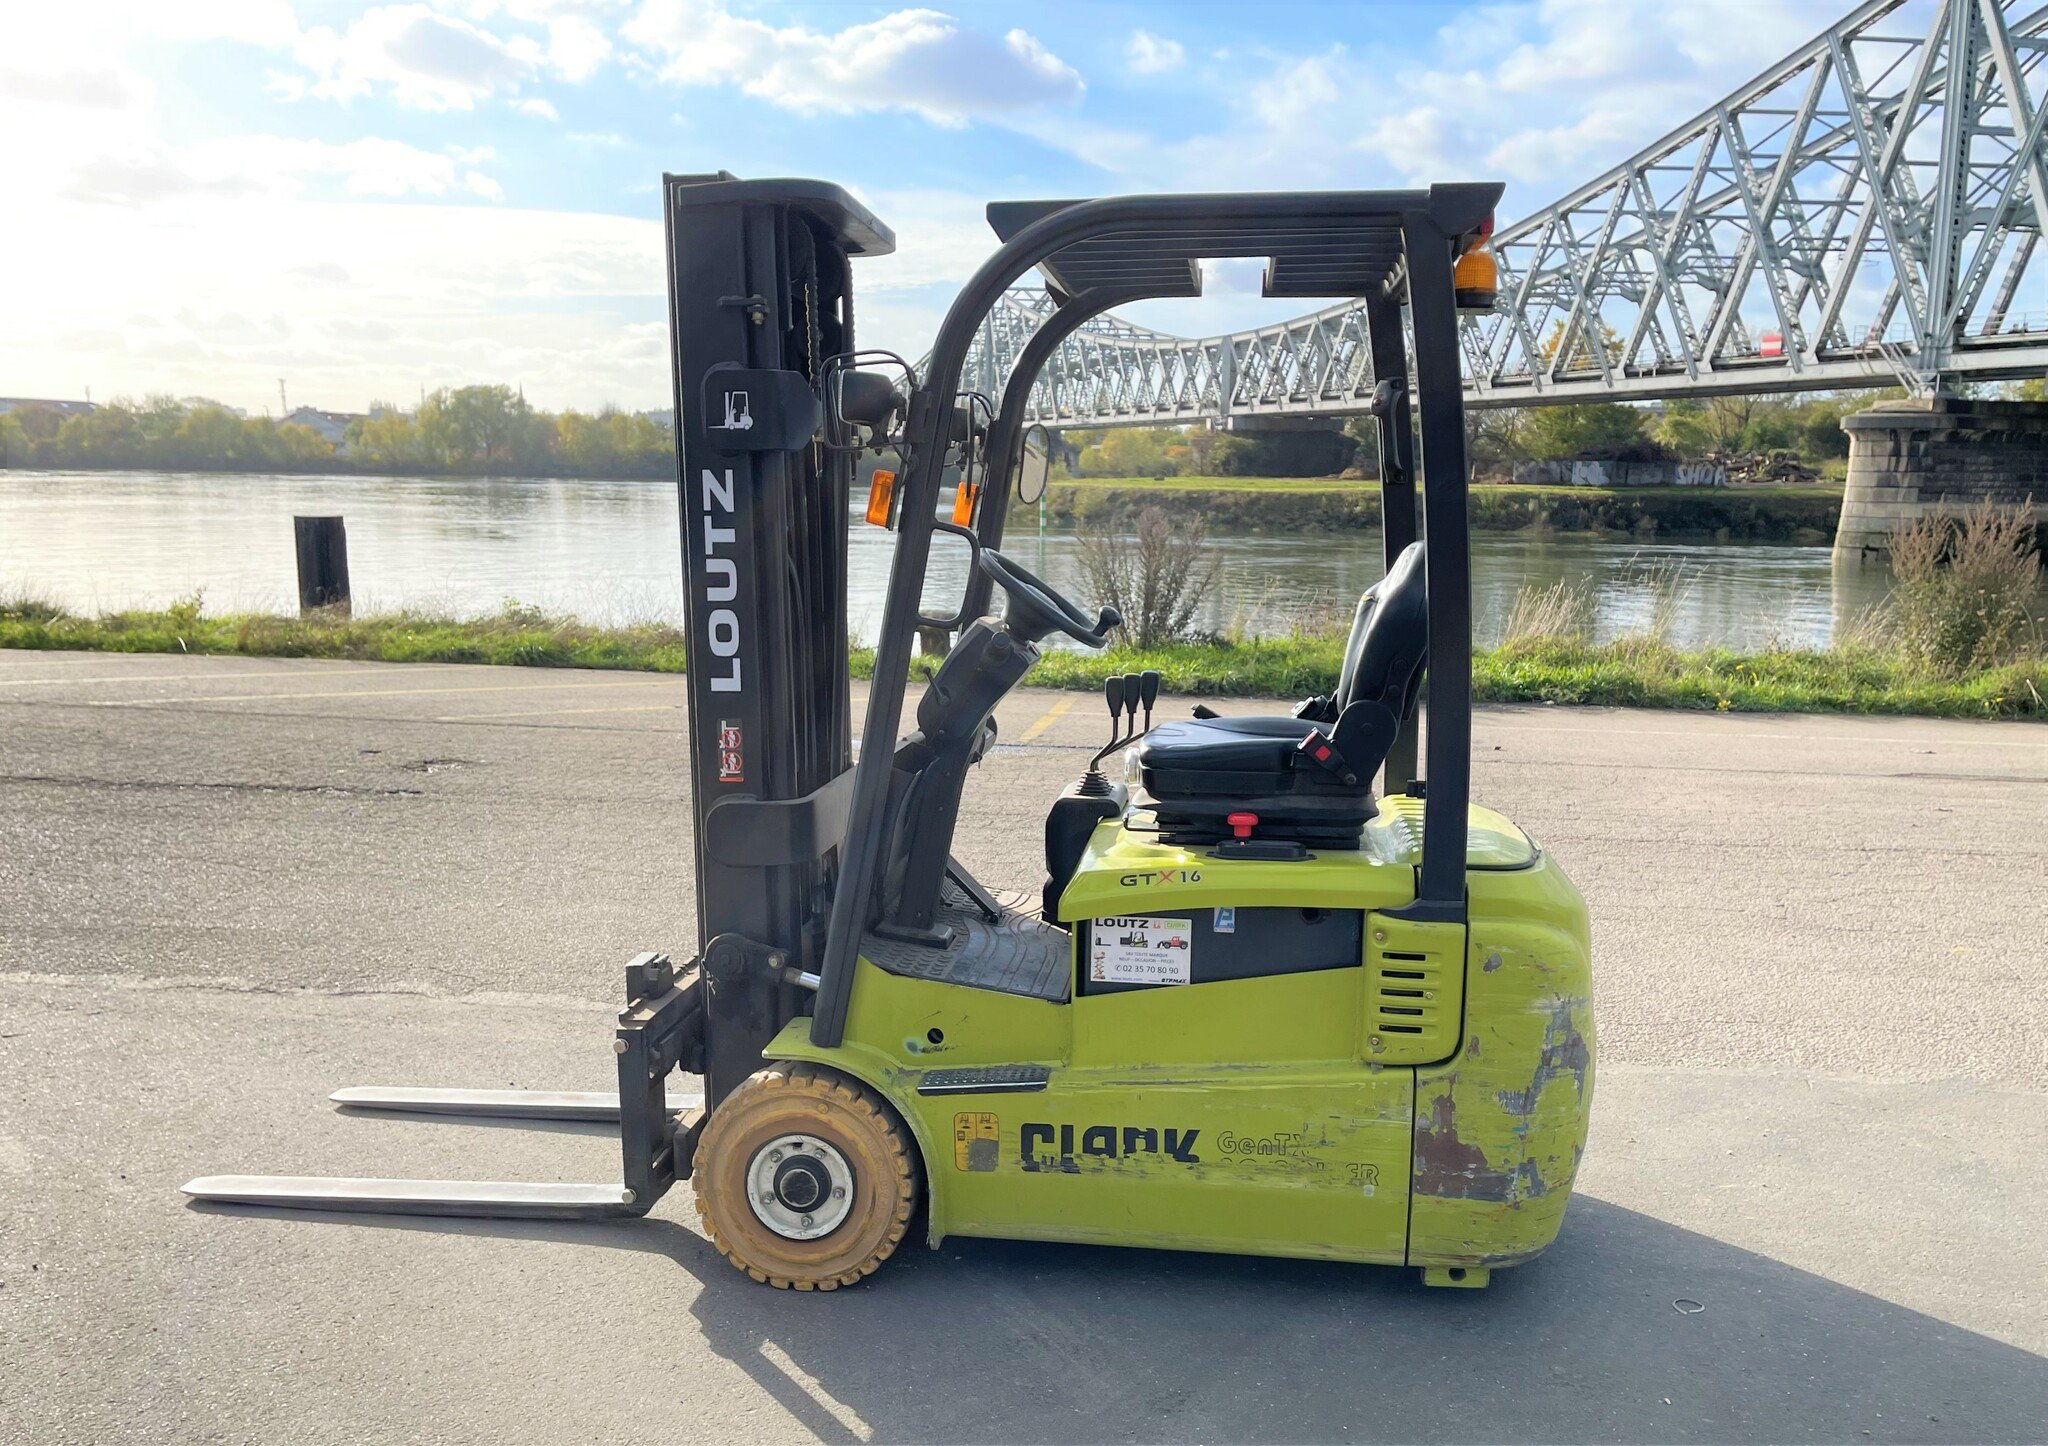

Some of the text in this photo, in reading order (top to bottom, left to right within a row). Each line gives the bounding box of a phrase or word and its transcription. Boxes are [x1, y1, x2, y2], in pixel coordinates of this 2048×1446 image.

[702, 469, 742, 692] LOUTZ
[1120, 869, 1201, 887] GTX 16
[1095, 917, 1149, 929] LOUTZ
[1122, 964, 1179, 975] 02 35 70 80 90
